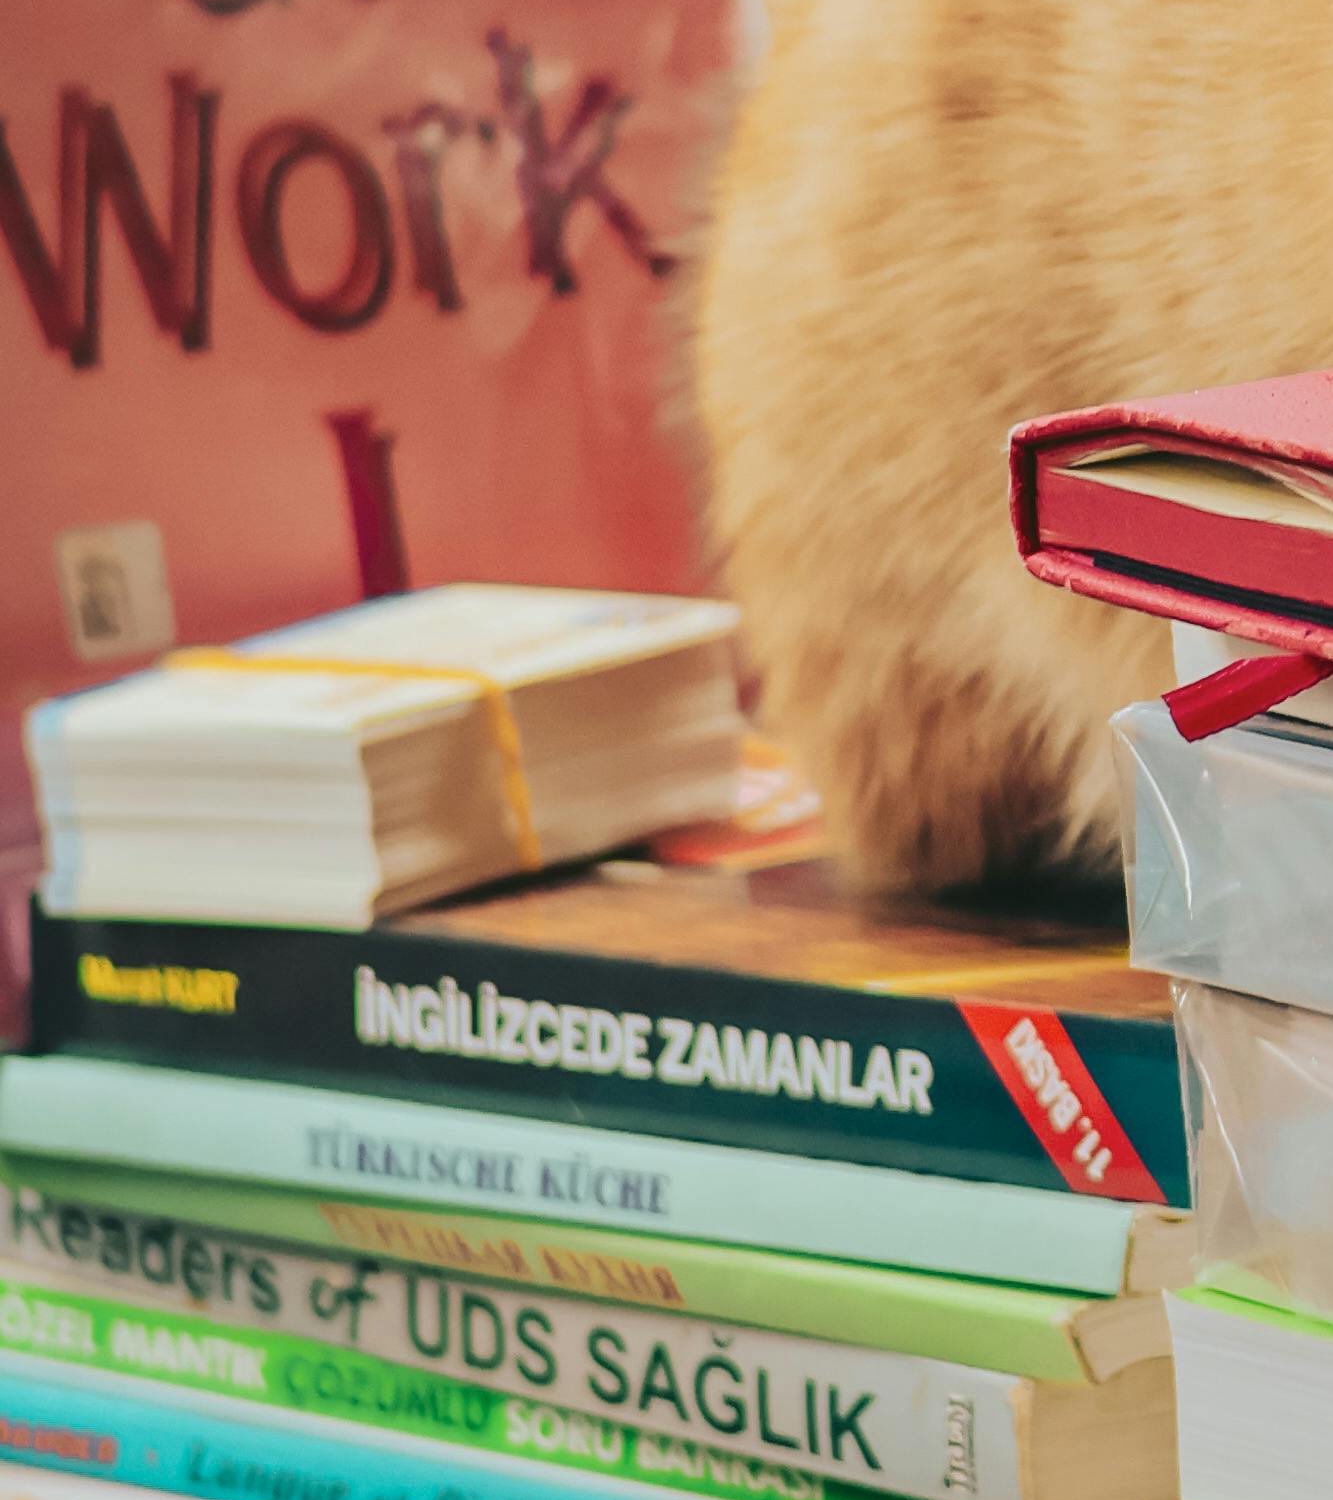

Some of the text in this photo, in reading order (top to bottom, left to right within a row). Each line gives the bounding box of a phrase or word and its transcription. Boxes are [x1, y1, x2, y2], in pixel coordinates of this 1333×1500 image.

[657, 1014, 935, 1116] ZAMANLAR
[309, 1256, 380, 1341] of
[586, 1323, 884, 1472] SAĞLIK
[506, 1396, 625, 1464] SORU
